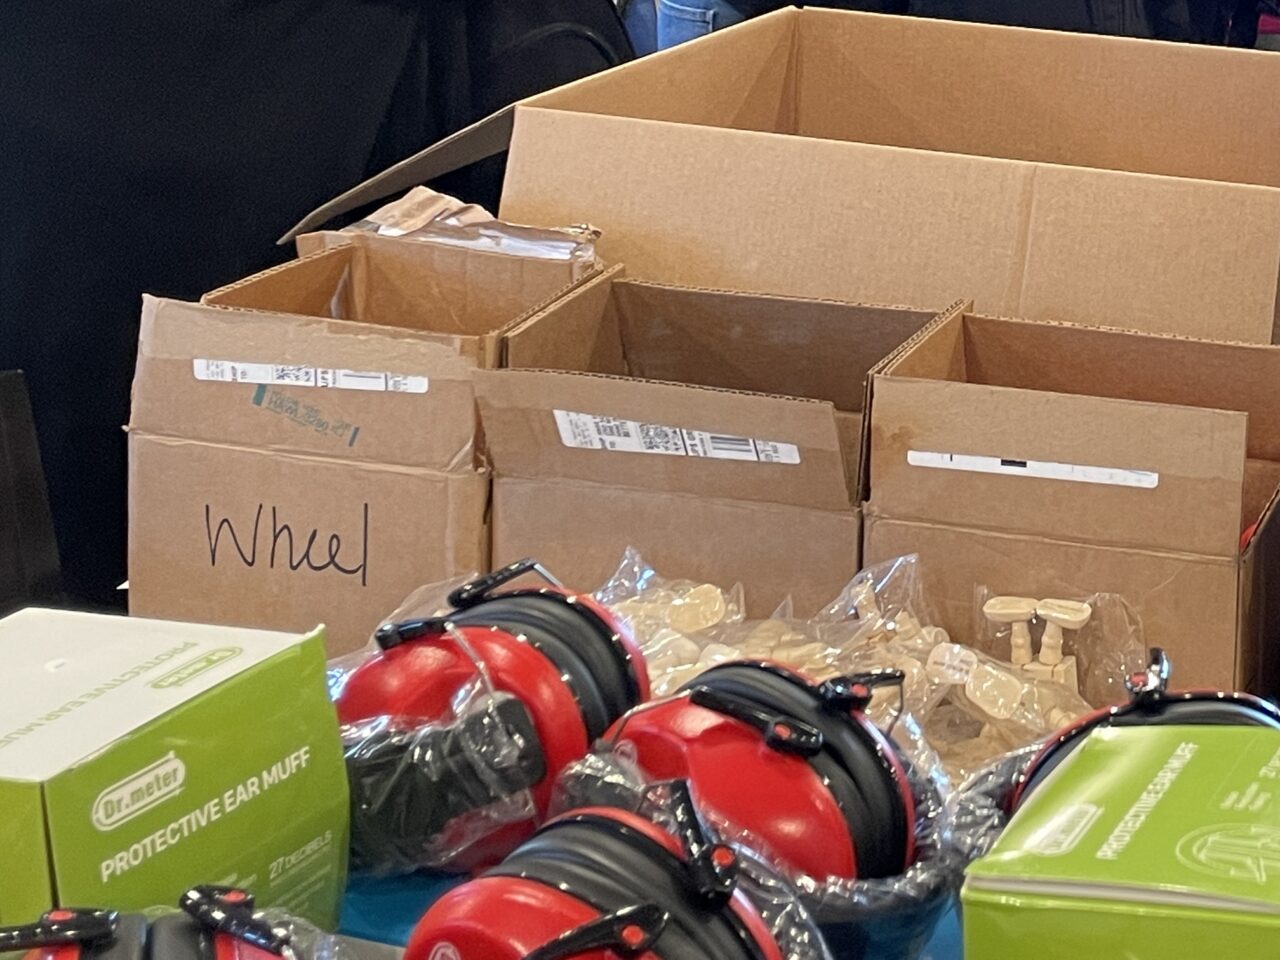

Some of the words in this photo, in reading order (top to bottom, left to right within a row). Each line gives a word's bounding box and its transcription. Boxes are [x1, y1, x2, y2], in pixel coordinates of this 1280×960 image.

[205, 502, 368, 587] Wheel
[100, 797, 223, 883] PROTECTIVE
[223, 775, 261, 814] EAR
[261, 745, 311, 790] MUFF
[102, 765, 179, 821] Dr.meter
[268, 858, 284, 880] 27
[284, 830, 332, 869] DECIBELS
